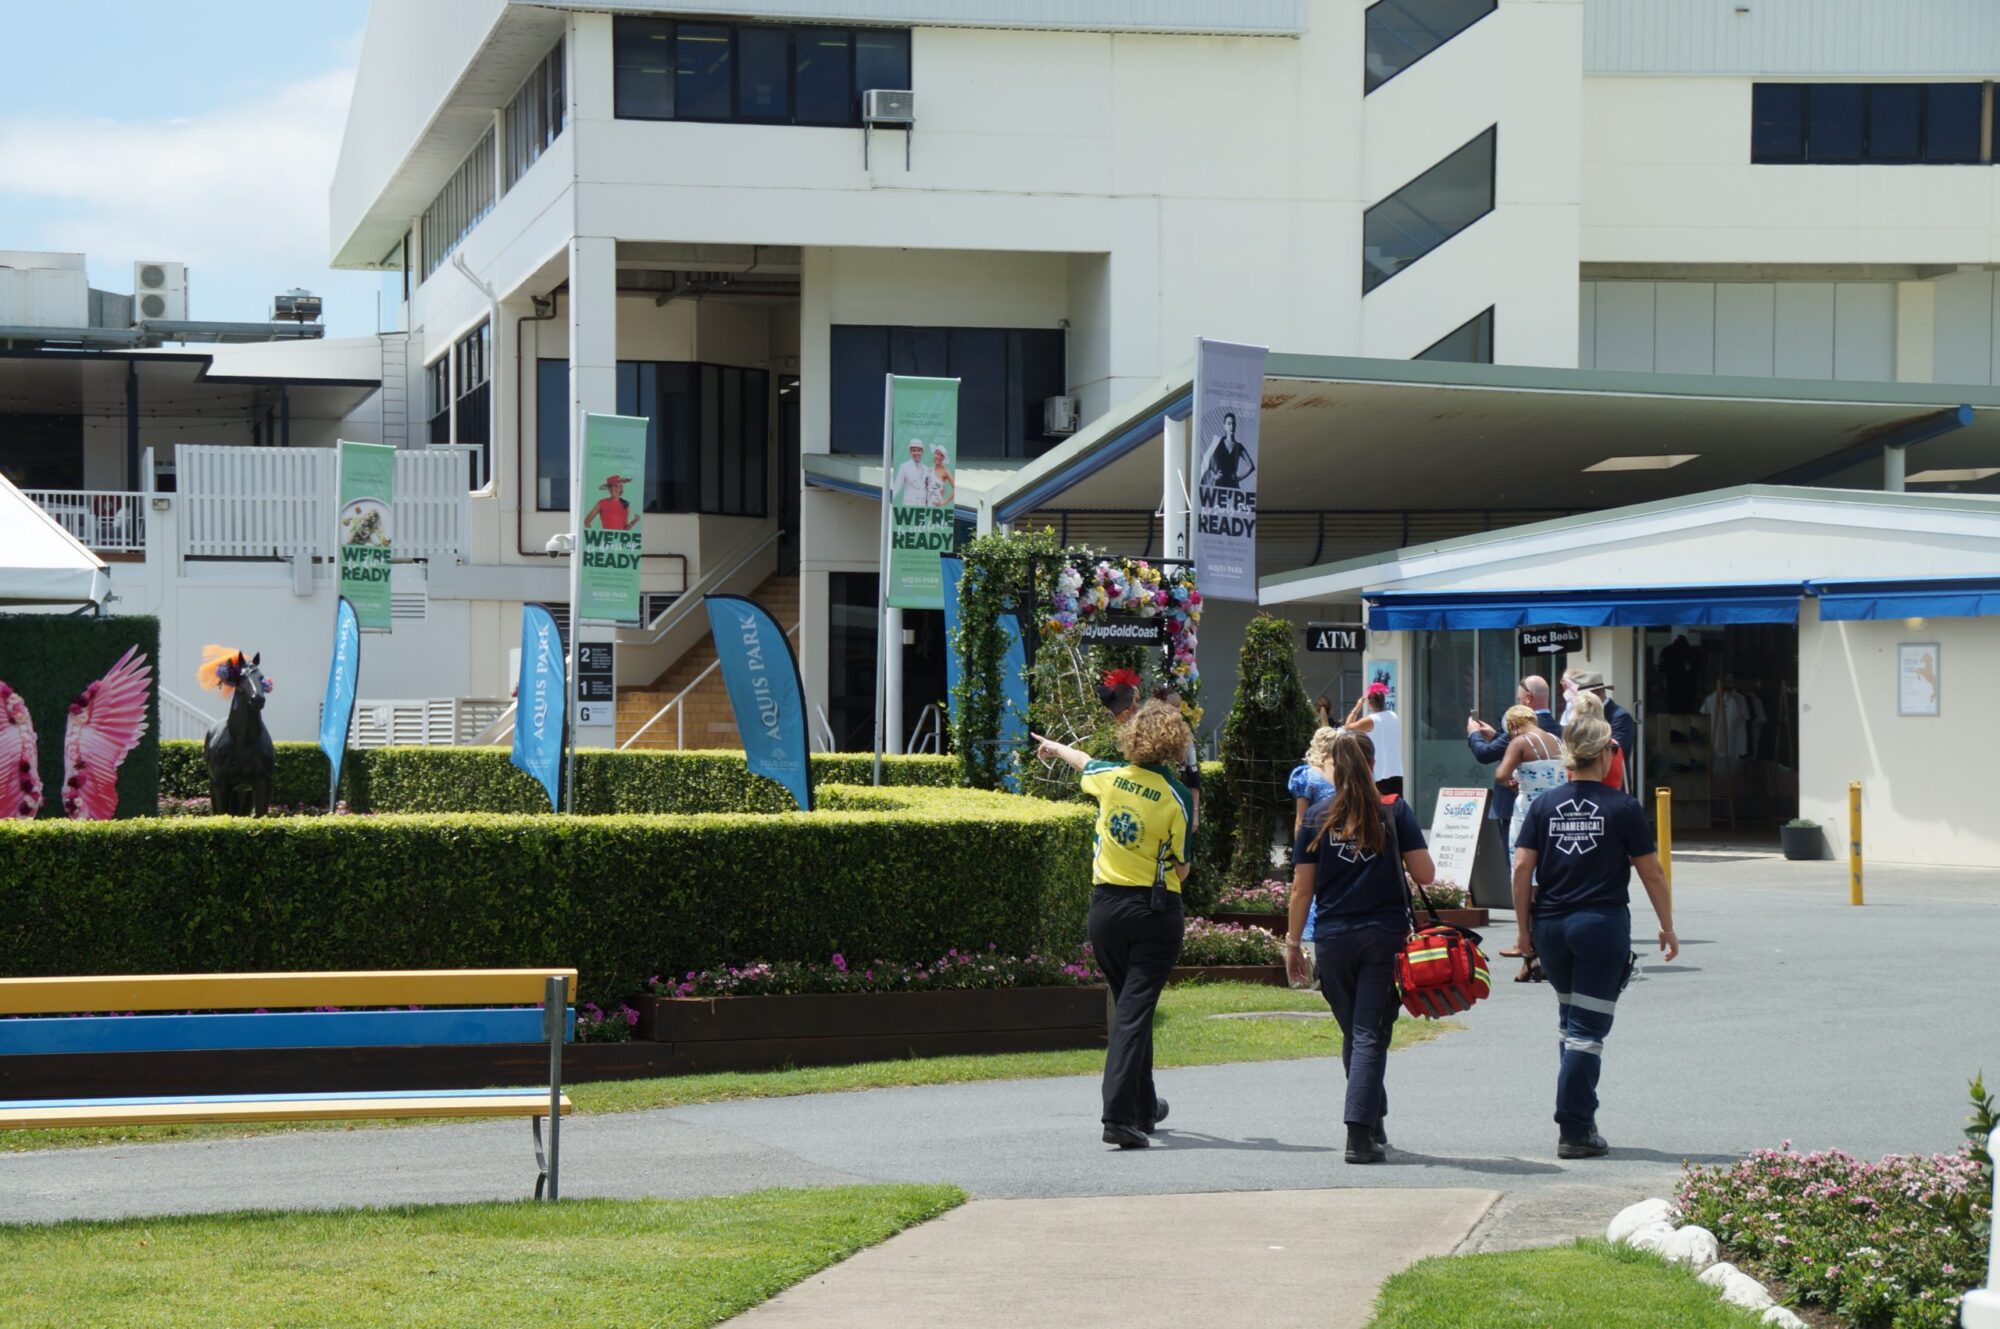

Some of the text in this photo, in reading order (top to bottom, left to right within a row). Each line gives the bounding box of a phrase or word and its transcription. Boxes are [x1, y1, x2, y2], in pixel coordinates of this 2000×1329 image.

[1199, 486, 1257, 513] WE'RE
[893, 507, 954, 527] WE'RE
[1198, 513, 1257, 539] READY
[583, 529, 642, 550] WE'RE
[892, 531, 954, 551] READY
[342, 546, 392, 564] WE'RE
[583, 551, 641, 570] READY
[342, 566, 391, 582] READY
[1316, 630, 1358, 649] ATM
[1523, 630, 1580, 645] Race Books
[580, 647, 591, 662] 2
[533, 623, 550, 741] AQUIS PARK
[739, 613, 782, 741] AQUIS PARK
[580, 680, 588, 696] 1
[580, 706, 591, 722] G
[1113, 776, 1162, 802] FIRST AID
[1551, 821, 1601, 832] PARAMEDICAL
